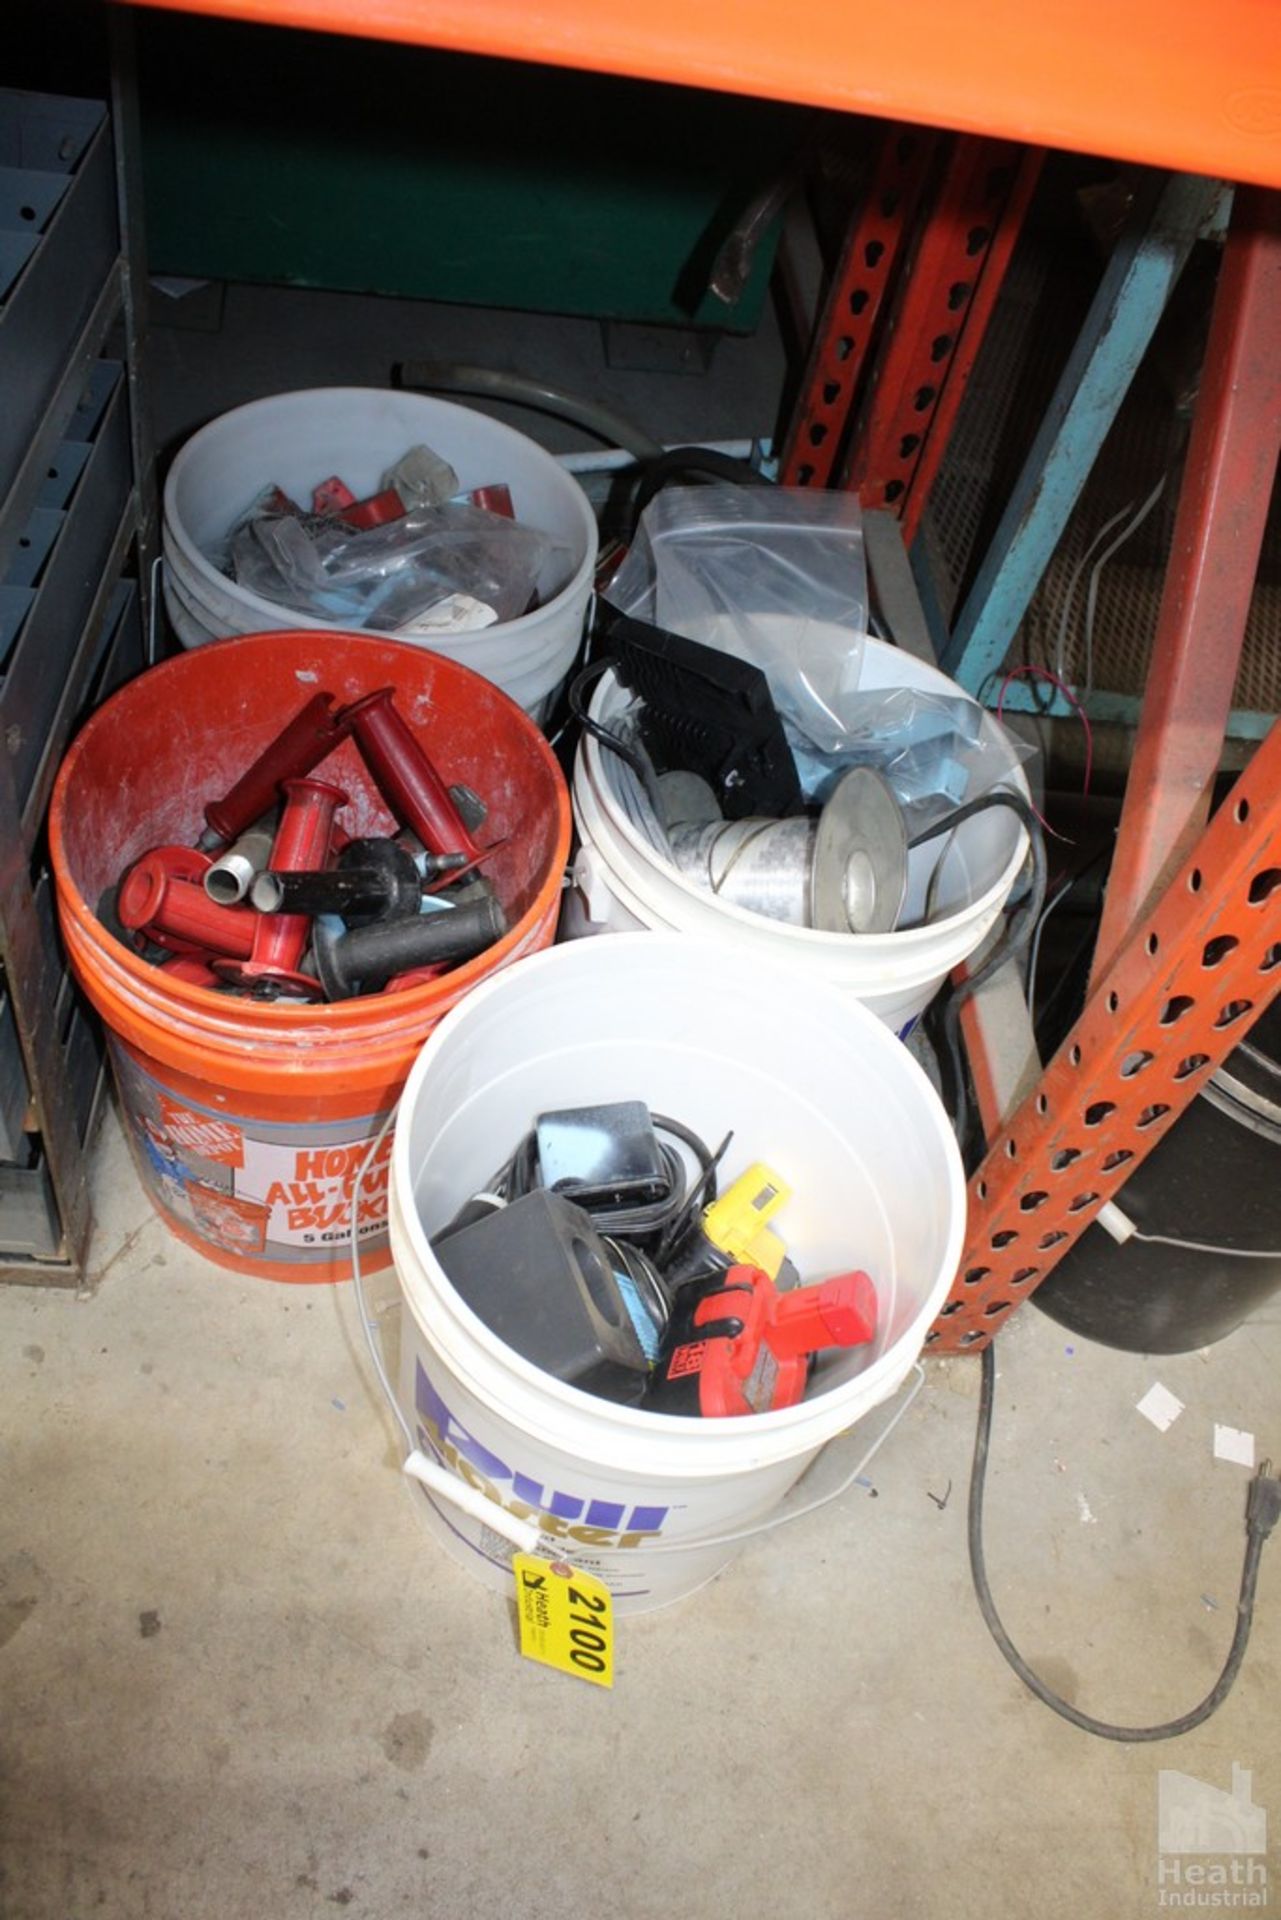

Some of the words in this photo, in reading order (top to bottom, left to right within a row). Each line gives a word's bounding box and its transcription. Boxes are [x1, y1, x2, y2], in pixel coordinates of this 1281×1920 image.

[294, 1132, 396, 1181] HOME
[265, 1167, 390, 1206] ALL-PU
[288, 1195, 388, 1231] BUCK
[303, 1233, 316, 1243] 5
[321, 1220, 389, 1242] Galons
[535, 1591, 551, 1628] Heath
[568, 1585, 607, 1673] 2100
